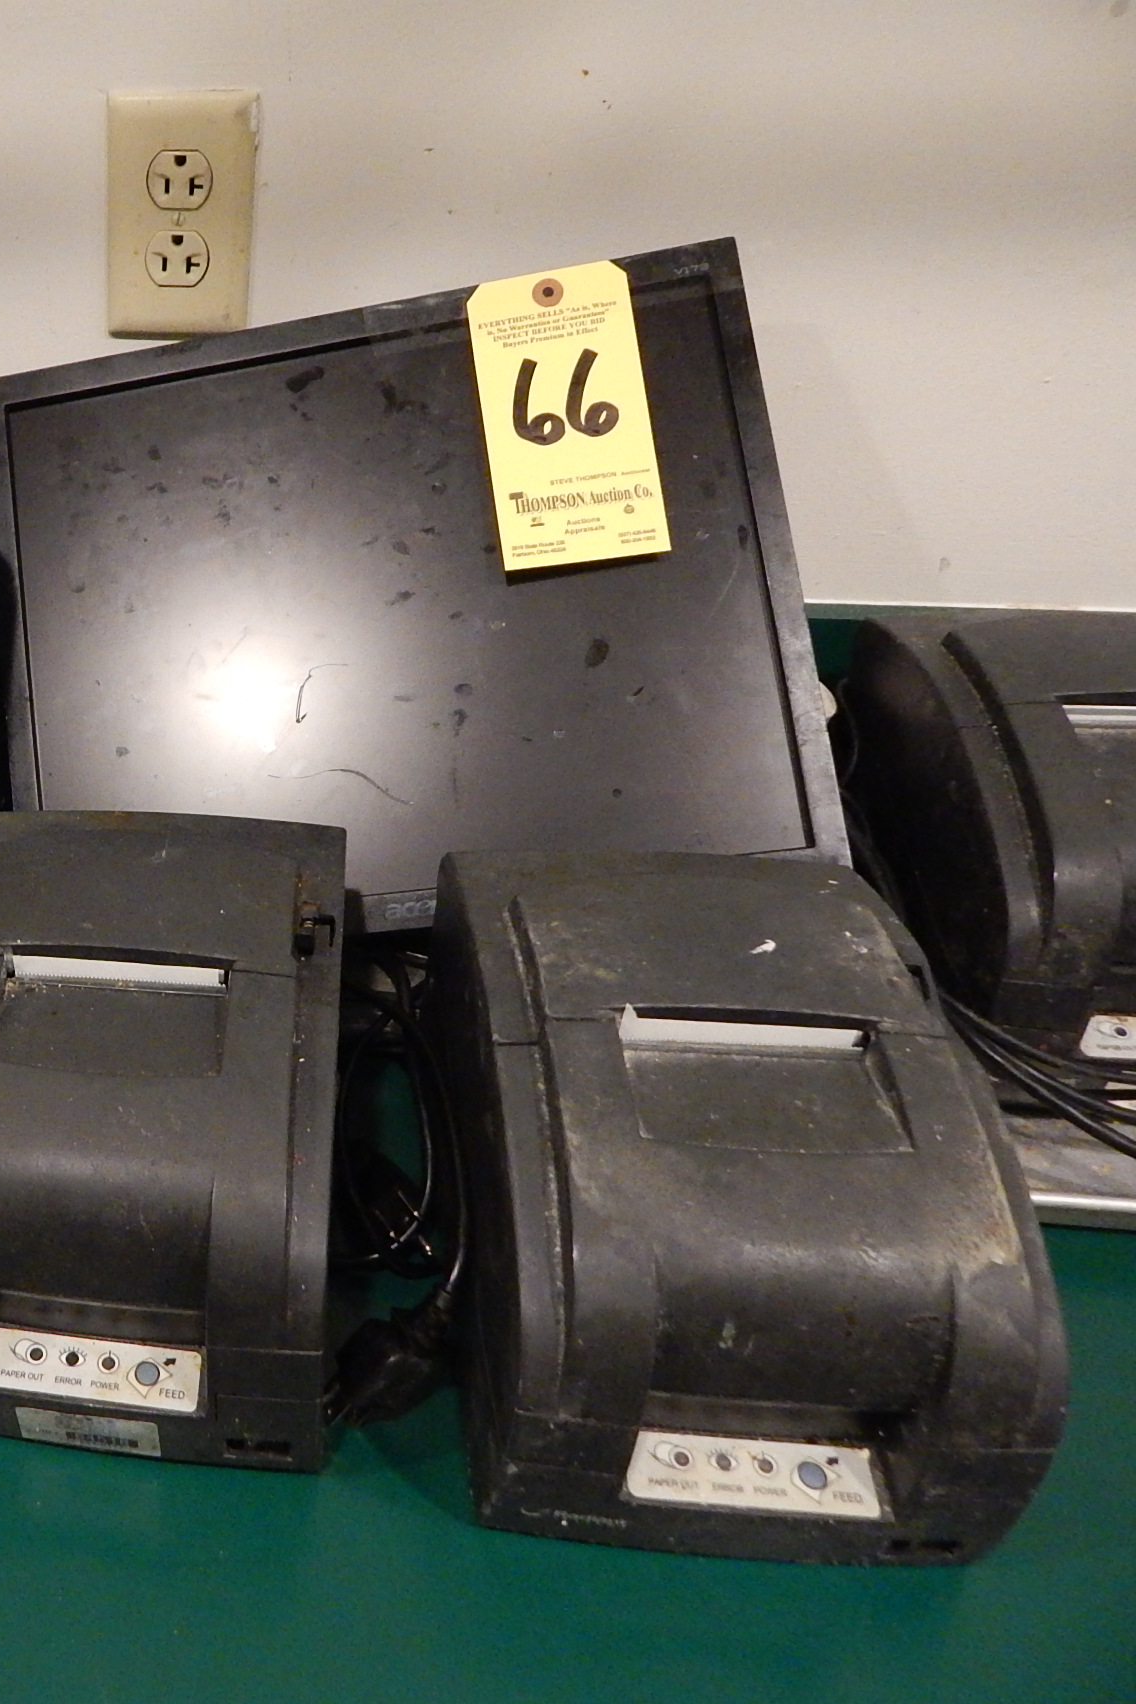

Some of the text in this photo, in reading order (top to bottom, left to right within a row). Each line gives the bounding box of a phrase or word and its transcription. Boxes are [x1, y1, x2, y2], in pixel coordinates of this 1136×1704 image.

[478, 313, 535, 330] EVERYTHING
[537, 309, 564, 319] SELLS
[592, 300, 617, 309] Where
[493, 317, 606, 342] INSPECT BEFORE YOU BID
[502, 339, 529, 349] Buyers
[530, 332, 565, 344] Premium
[576, 326, 599, 336] Effect
[513, 348, 619, 446] 66
[550, 476, 573, 486] STEVE
[576, 472, 617, 482] THOMPSON
[509, 491, 587, 515] THOMPSON
[590, 486, 632, 505] Auction
[566, 516, 601, 526] Auctions
[564, 524, 605, 535] Appraisals
[0, 1368, 44, 1382] PAPER OUT
[54, 1375, 82, 1387] ERROR
[90, 1380, 120, 1391] POWER
[158, 1387, 186, 1400] FEED
[648, 1476, 700, 1491] PAPER OUT
[752, 1485, 788, 1498] POWER
[831, 1490, 863, 1504] FEED
